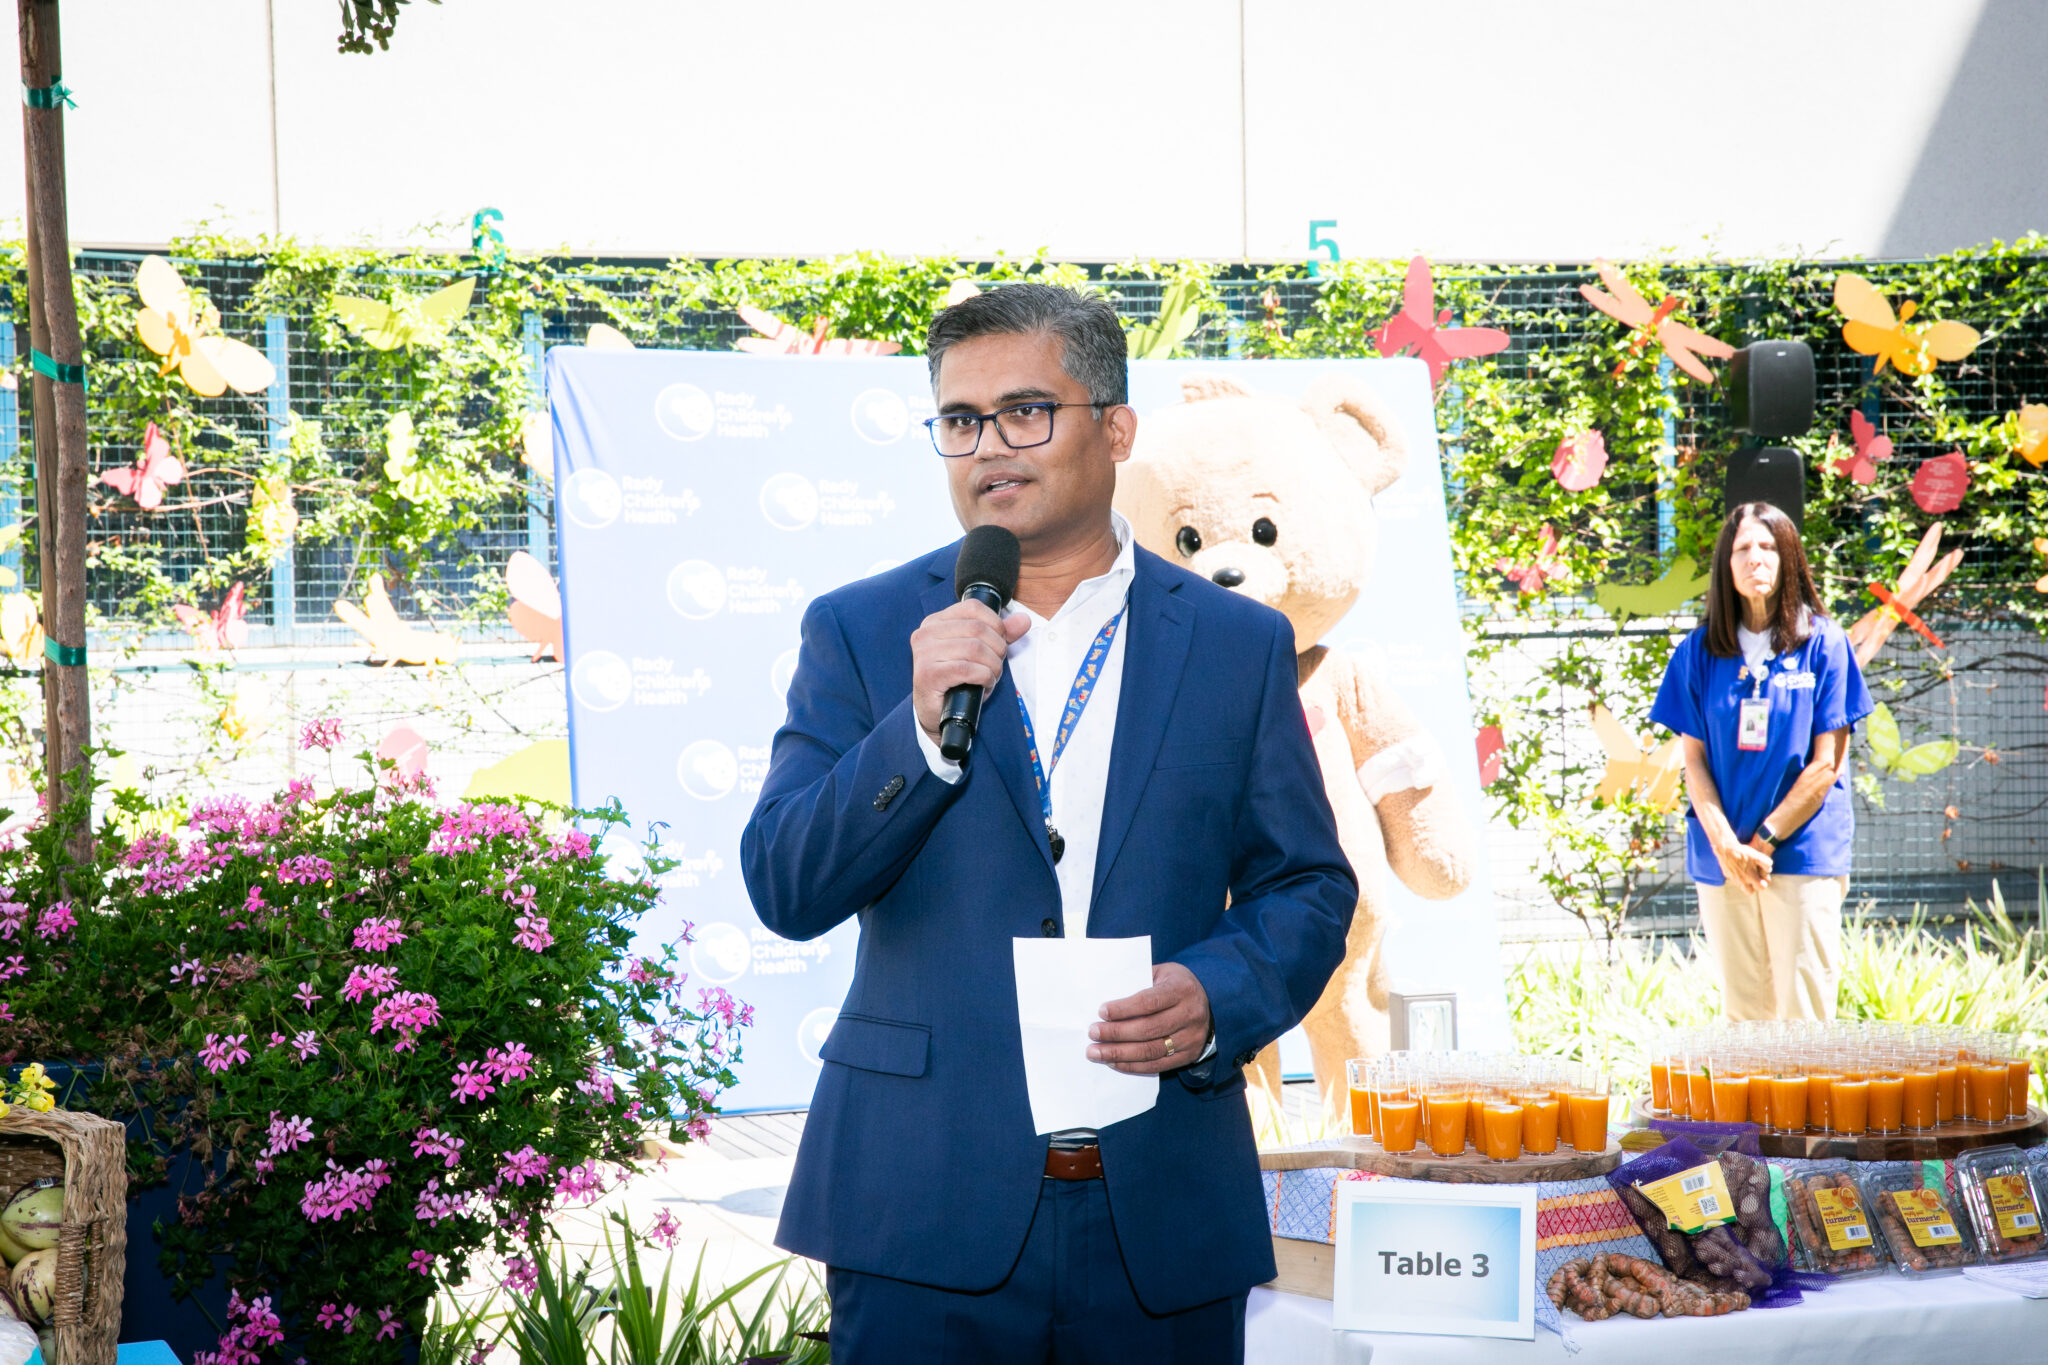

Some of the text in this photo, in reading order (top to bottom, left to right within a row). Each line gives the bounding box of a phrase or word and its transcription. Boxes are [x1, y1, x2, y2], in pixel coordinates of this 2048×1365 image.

[472, 208, 505, 272] 6
[1307, 220, 1341, 279] 5
[715, 391, 755, 408] Rady
[717, 423, 768, 438] Health
[622, 475, 663, 493] Rady
[818, 479, 859, 496] Rady
[624, 509, 677, 524] Health
[820, 511, 872, 525] Health
[726, 566, 768, 584] Rady
[729, 600, 781, 615] Health
[632, 656, 674, 675] Rady
[634, 689, 688, 704] Health
[738, 745, 770, 760] Rad
[753, 958, 807, 976] Health
[1378, 1251, 1490, 1278] Table 3
